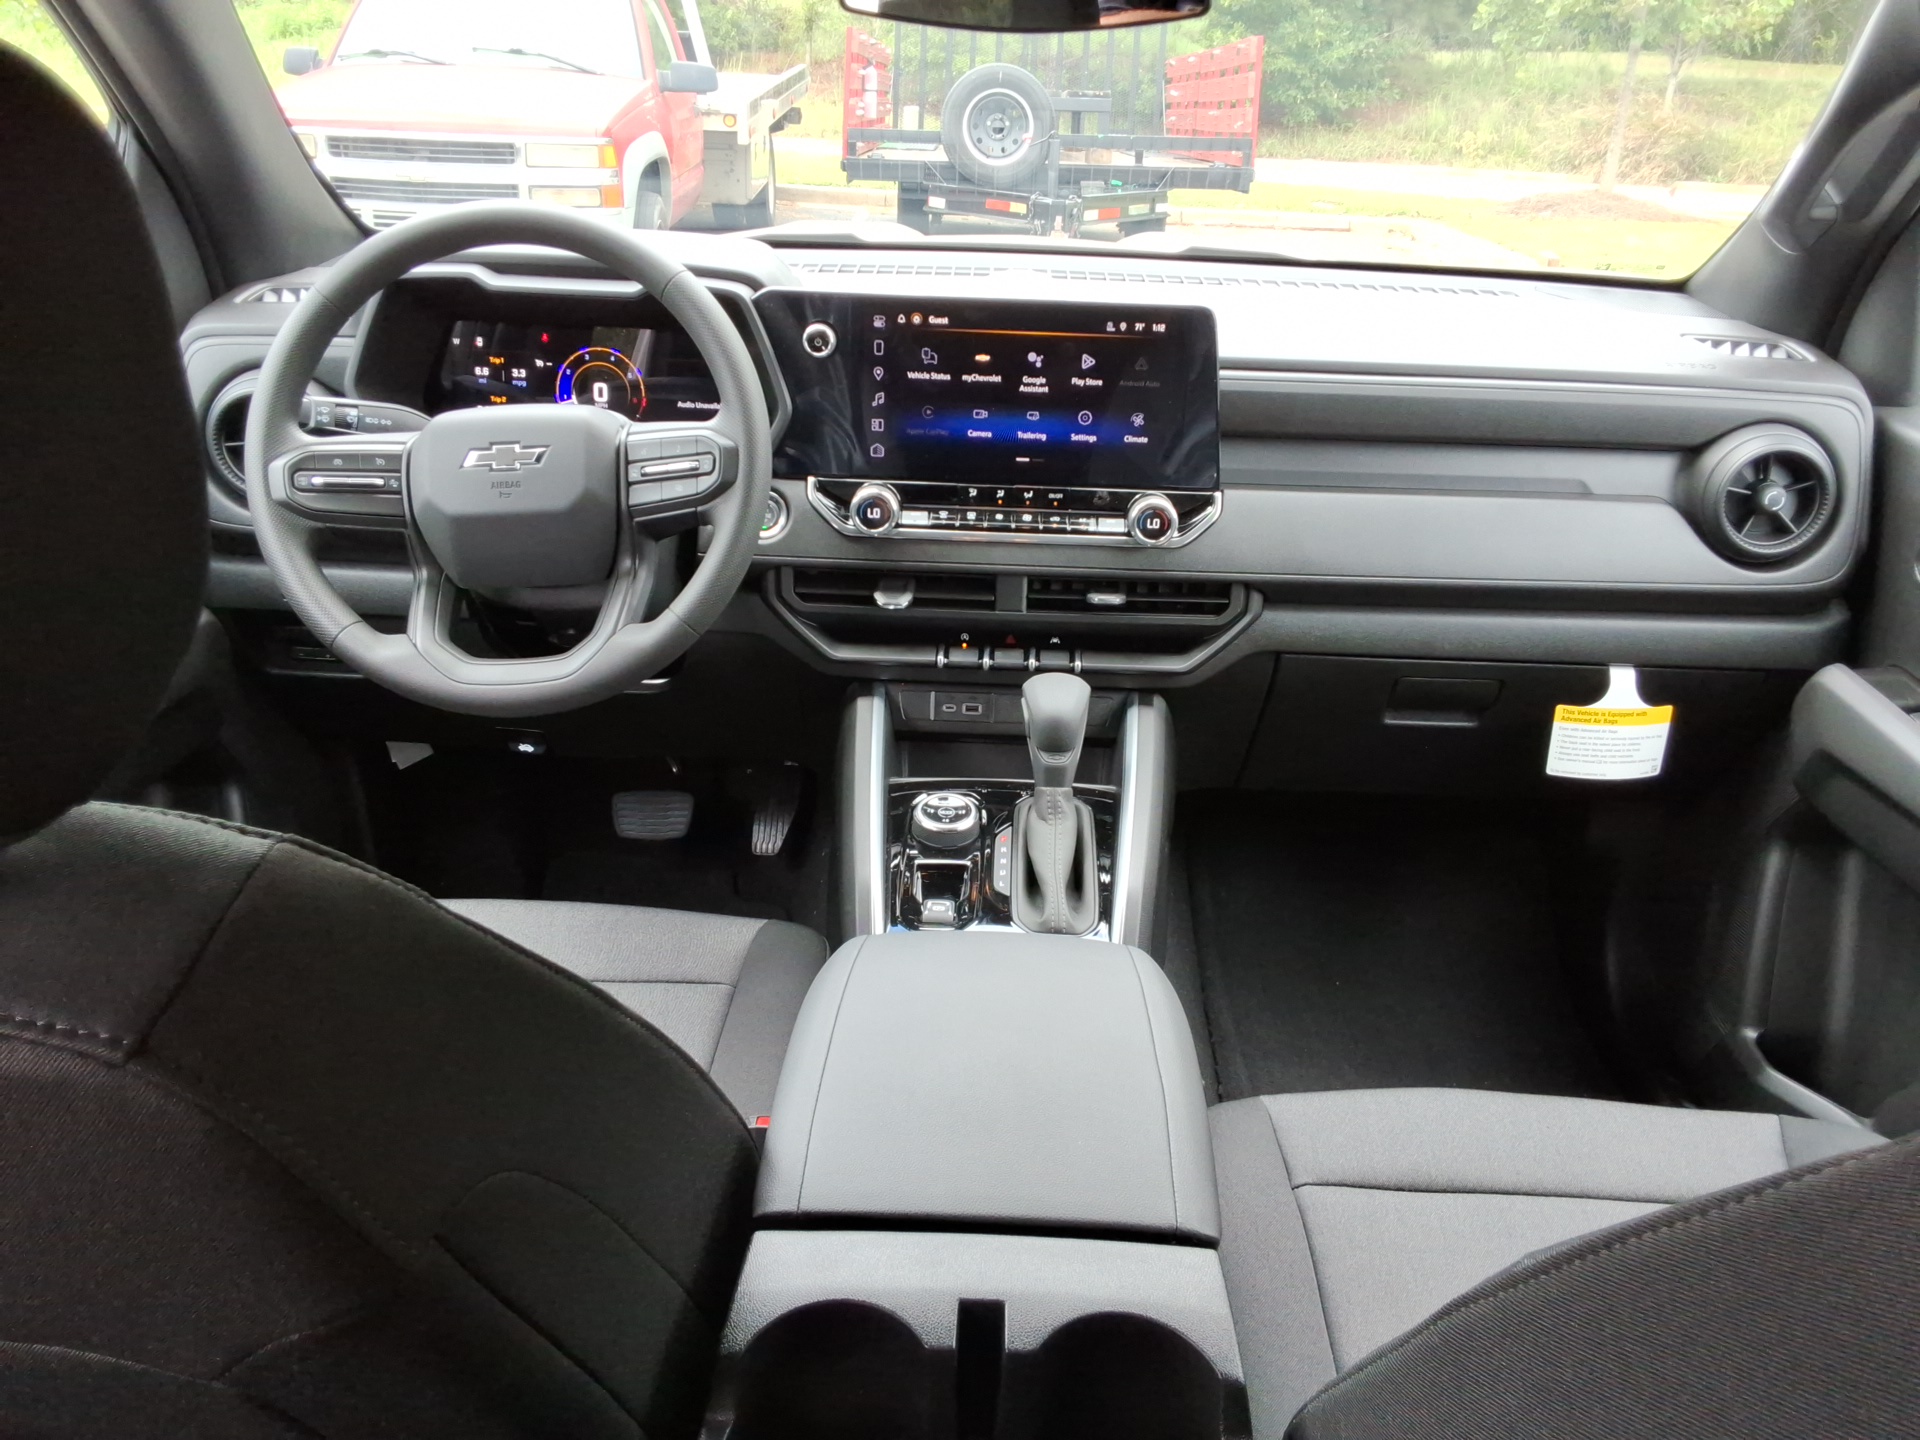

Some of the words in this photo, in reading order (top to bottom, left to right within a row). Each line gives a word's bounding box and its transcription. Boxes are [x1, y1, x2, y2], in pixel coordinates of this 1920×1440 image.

[928, 315, 949, 325] Guest
[1152, 323, 1166, 333] 1:12
[489, 356, 500, 364] Trip
[474, 366, 490, 376] 6.6
[511, 368, 527, 378] 3.3
[906, 371, 930, 380] Vehicle
[931, 372, 951, 381] Status
[962, 373, 1002, 383] myChevrolet
[1022, 375, 1047, 385] Google
[1071, 377, 1085, 387] Play
[1085, 378, 1104, 387] Store
[512, 380, 527, 388] mpg
[1018, 384, 1049, 393] Assistant
[593, 382, 608, 403] 0
[490, 395, 501, 404] Trip
[677, 400, 695, 409] Audio
[967, 429, 992, 438] Camera
[1017, 430, 1047, 442] Trailering
[1070, 432, 1097, 443] Settings
[1123, 434, 1149, 444] Climate
[490, 480, 521, 490] AIRBAG
[867, 507, 881, 519] LO
[1146, 518, 1161, 529] LO
[1562, 708, 1576, 716] This
